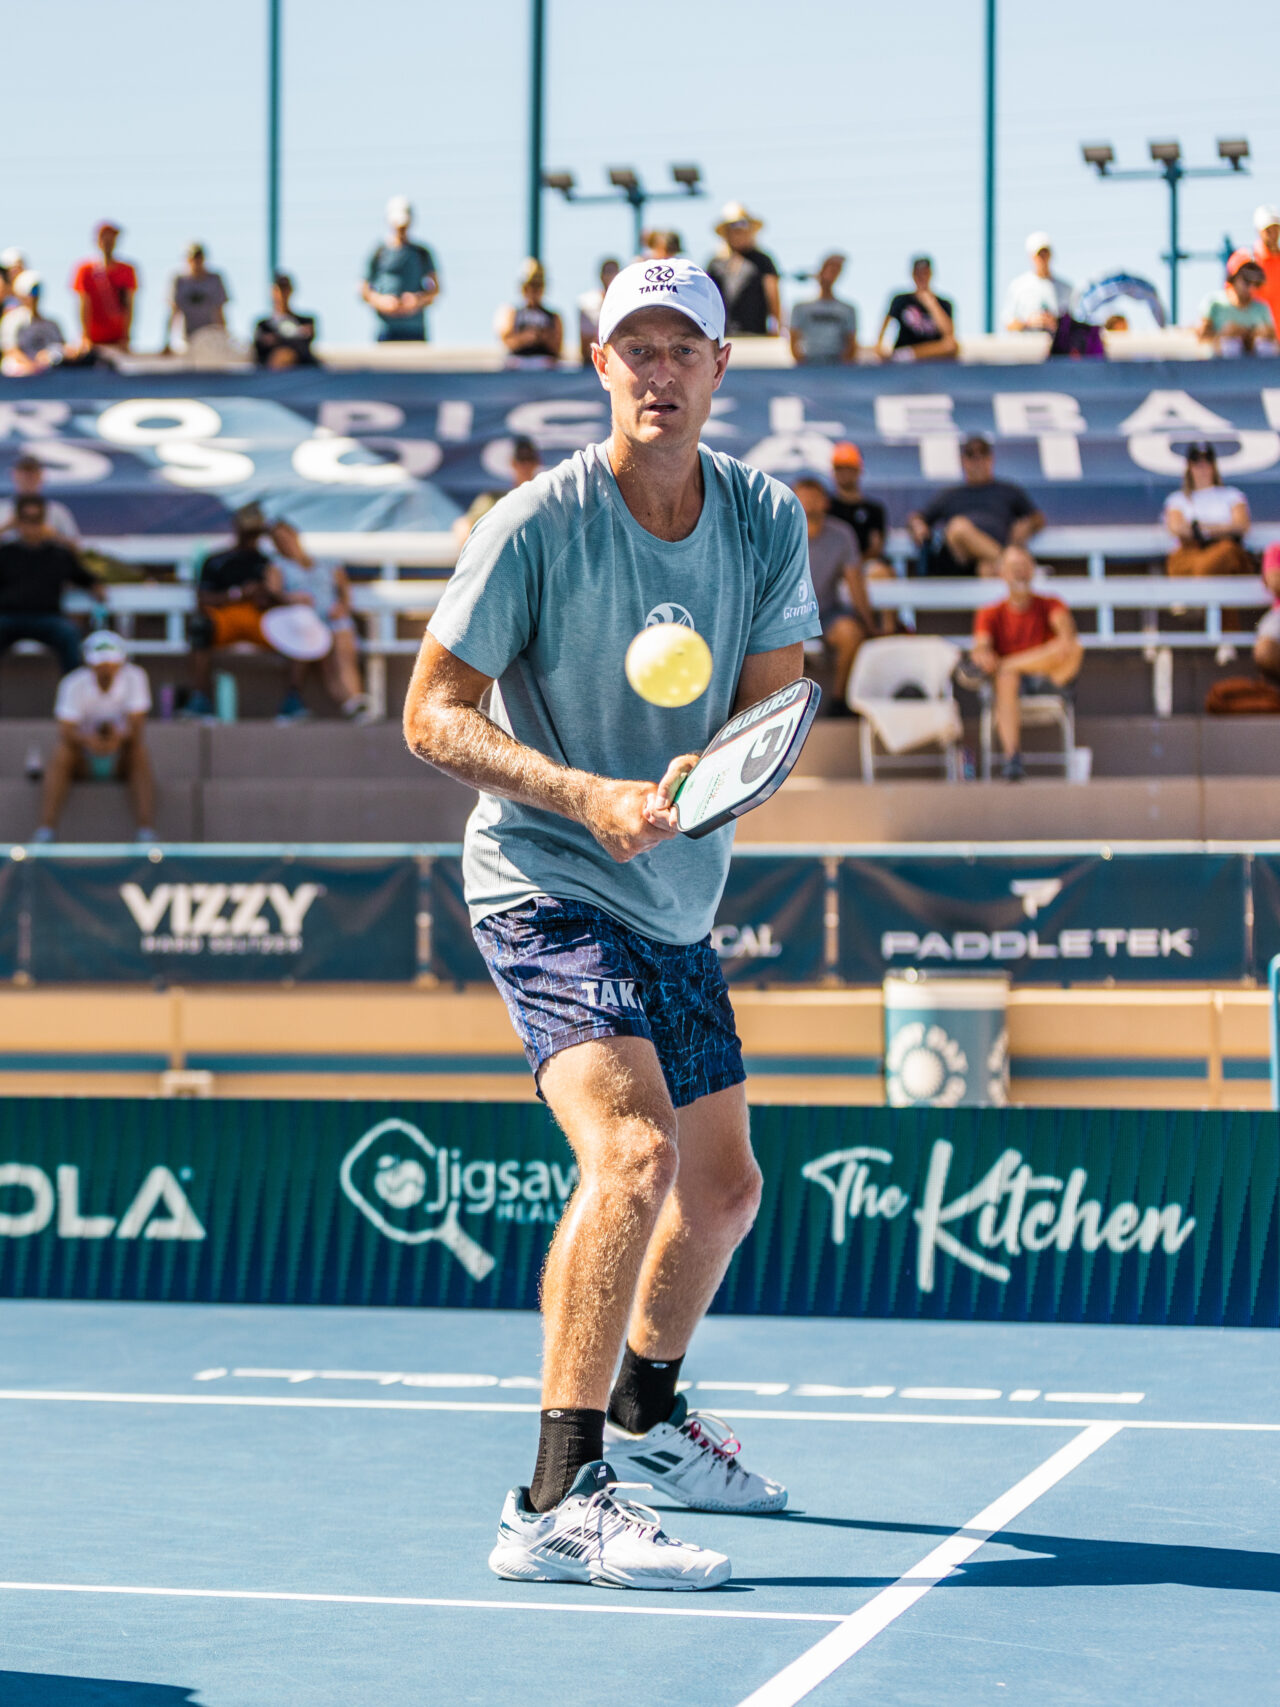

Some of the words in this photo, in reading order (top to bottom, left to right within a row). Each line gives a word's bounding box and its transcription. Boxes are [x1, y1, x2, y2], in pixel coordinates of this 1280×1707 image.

[320, 387, 1280, 446] PICLEBA
[121, 883, 319, 936] VIZZY
[881, 928, 1193, 960] PADDLETEK
[581, 981, 645, 1012] TAK
[802, 1146, 909, 1245] The
[914, 1139, 1197, 1293] Kitchen
